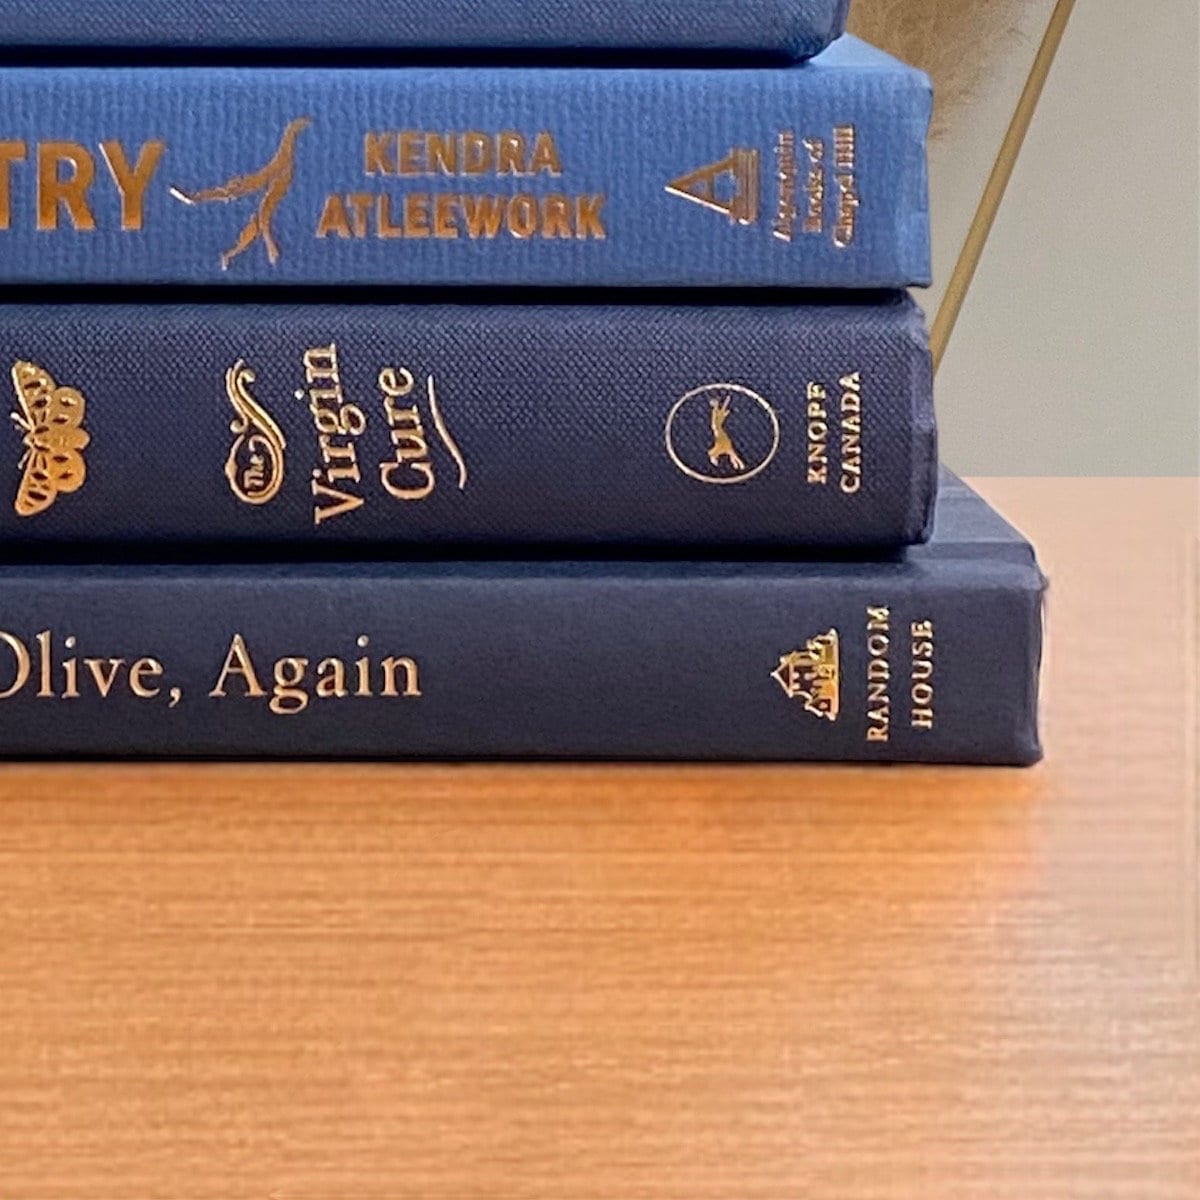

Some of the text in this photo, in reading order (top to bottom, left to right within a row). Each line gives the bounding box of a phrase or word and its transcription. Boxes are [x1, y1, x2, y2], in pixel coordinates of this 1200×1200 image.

[363, 130, 562, 178] KENDRA
[315, 192, 607, 240] ATLEEWORK
[294, 342, 367, 526] Virgin
[378, 366, 436, 501] Cure
[806, 381, 828, 485] KNOPF
[839, 371, 862, 494] CANADA
[208, 632, 423, 715] Again
[866, 605, 891, 743] RANDOM
[910, 619, 934, 730] HOUSE
